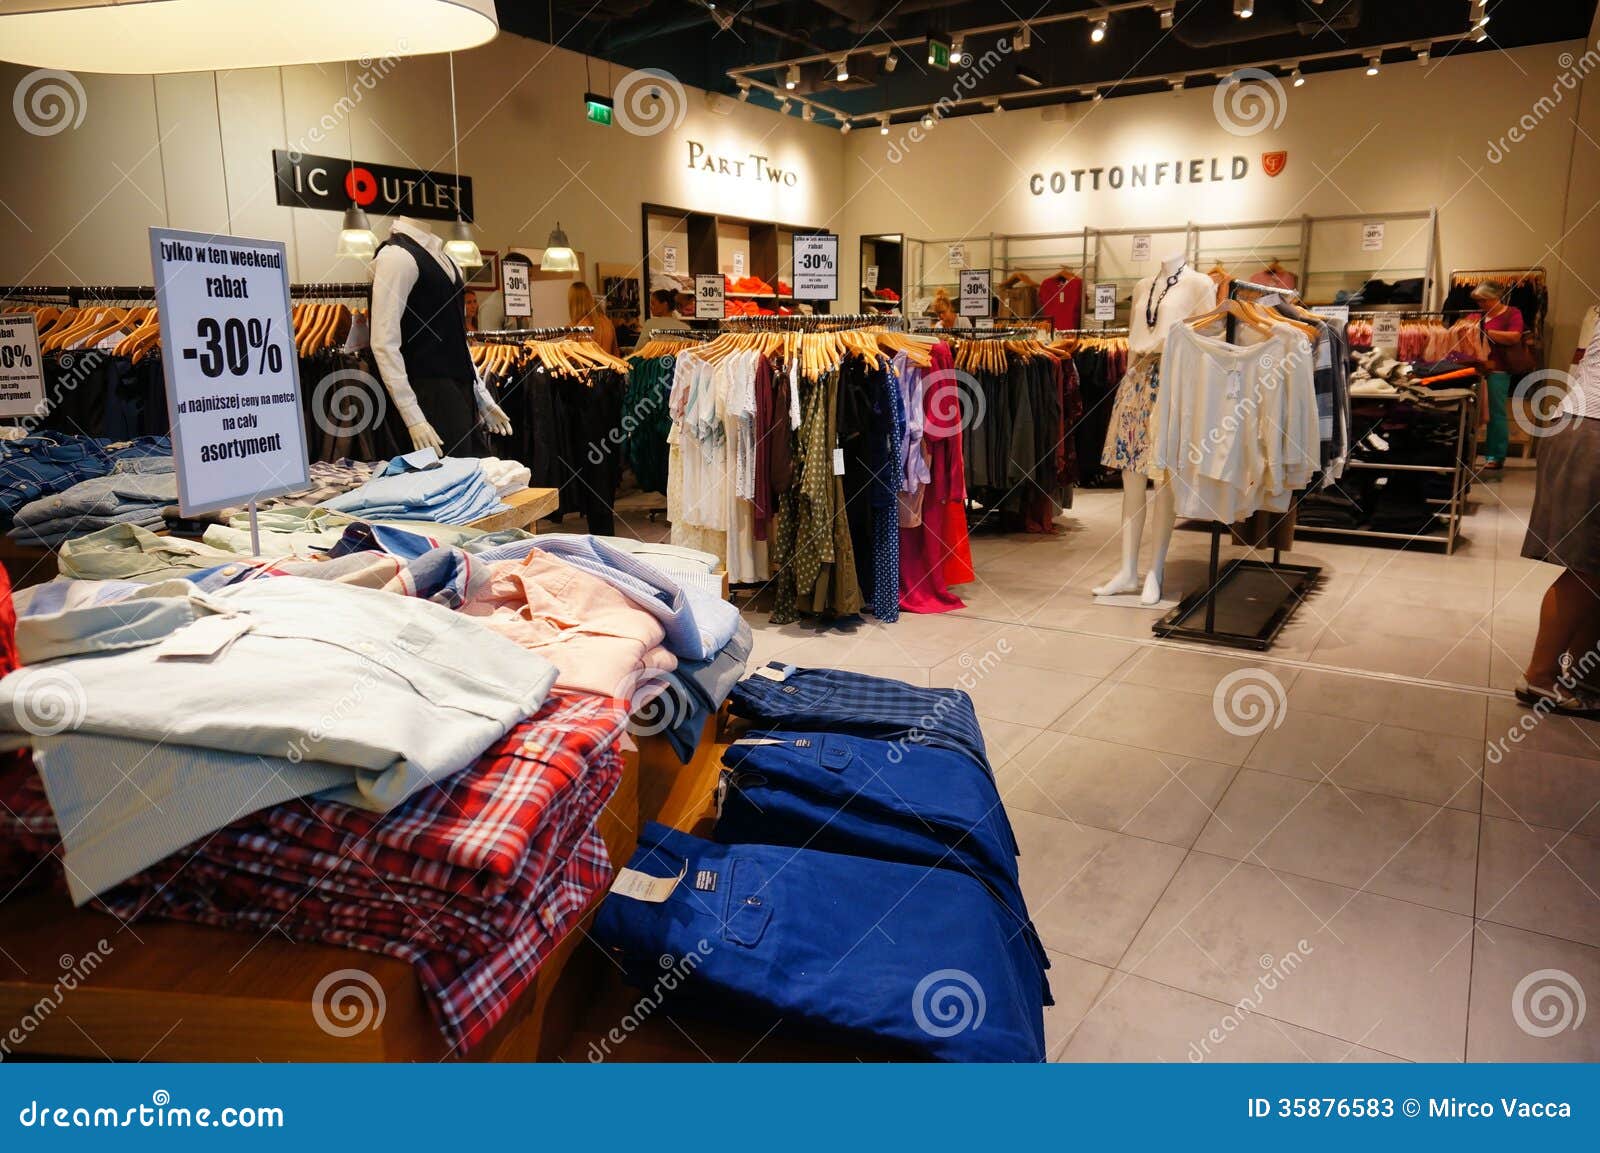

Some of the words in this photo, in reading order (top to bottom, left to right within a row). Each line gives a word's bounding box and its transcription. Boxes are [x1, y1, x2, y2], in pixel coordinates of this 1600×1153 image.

[293, 164, 329, 197] IC
[1029, 156, 1250, 196] COTTONFIELD
[160, 241, 193, 262] tylko
[195, 246, 206, 263] w
[207, 246, 229, 265] ten
[229, 249, 281, 269] weekend
[798, 254, 833, 269] -30%
[205, 274, 249, 299] rabat
[506, 276, 527, 290] -30%
[698, 286, 722, 297] -30%
[963, 283, 987, 294] -30%
[183, 317, 283, 378] -30%
[188, 393, 241, 413] najniższej
[241, 395, 260, 408] ceny
[260, 394, 271, 406] na
[271, 391, 295, 404] metce
[222, 417, 235, 431] na
[200, 432, 283, 463] asortyment
